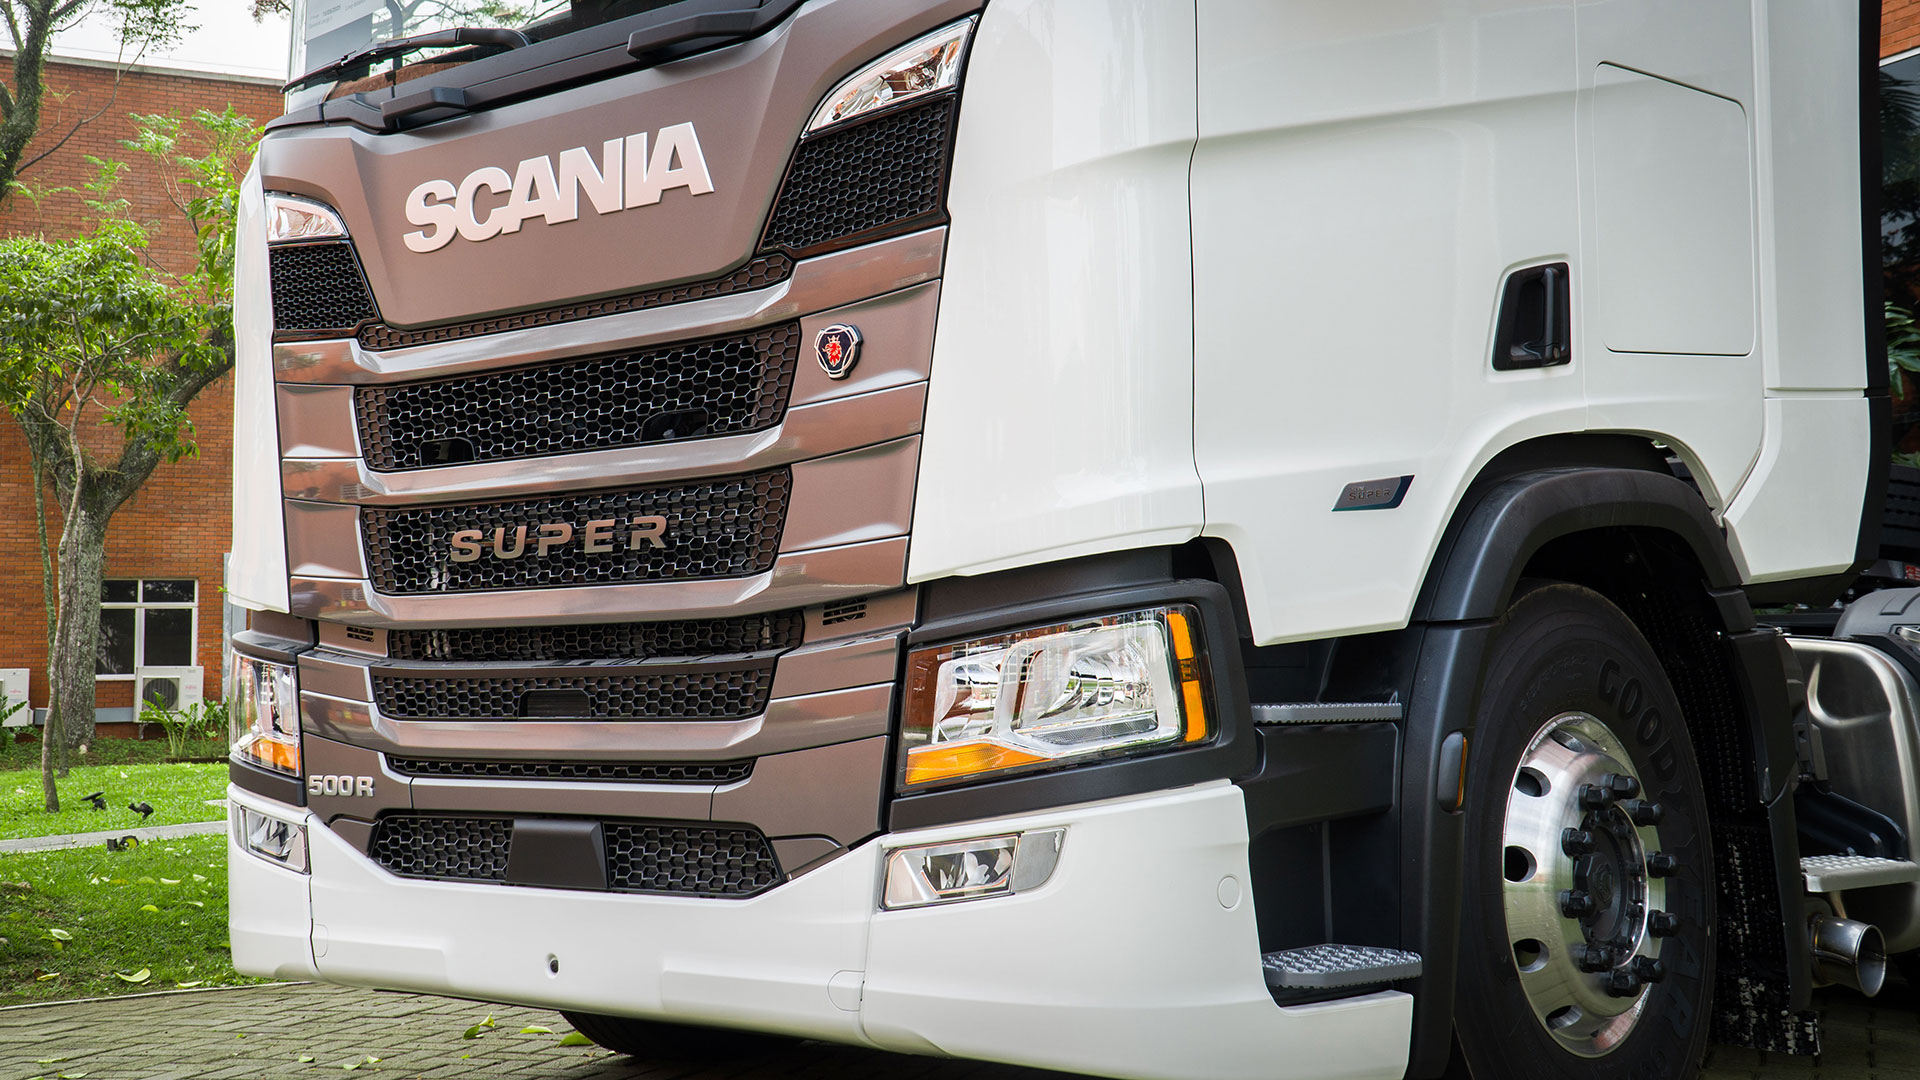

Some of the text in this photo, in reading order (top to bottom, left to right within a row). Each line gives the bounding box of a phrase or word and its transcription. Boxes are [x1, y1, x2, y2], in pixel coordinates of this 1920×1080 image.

[403, 121, 715, 253] SCANIA
[1349, 489, 1391, 501] SUPER
[451, 515, 667, 562] SUPER
